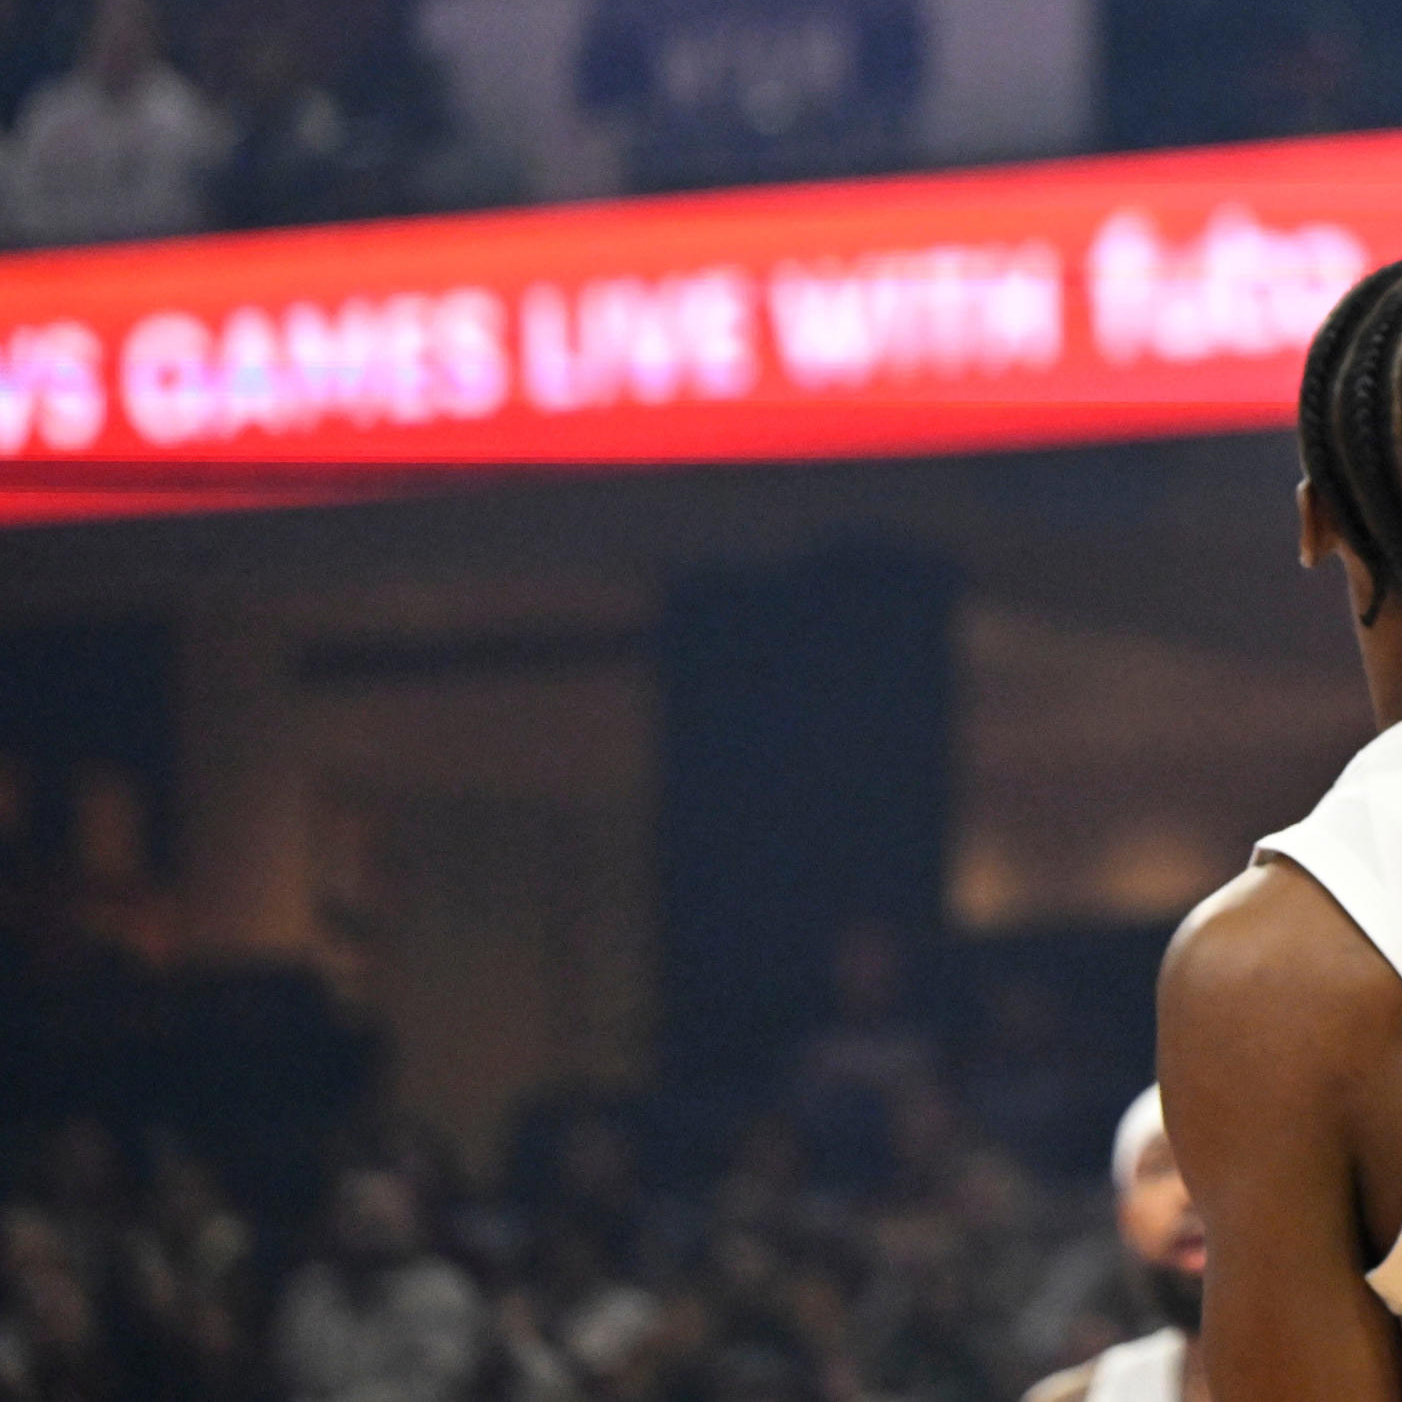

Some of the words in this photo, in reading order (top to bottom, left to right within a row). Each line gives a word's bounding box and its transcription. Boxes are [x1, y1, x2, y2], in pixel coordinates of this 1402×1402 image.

[122, 288, 508, 442] GAMES
[521, 266, 755, 410] LIVE
[767, 243, 1064, 388] WITH
